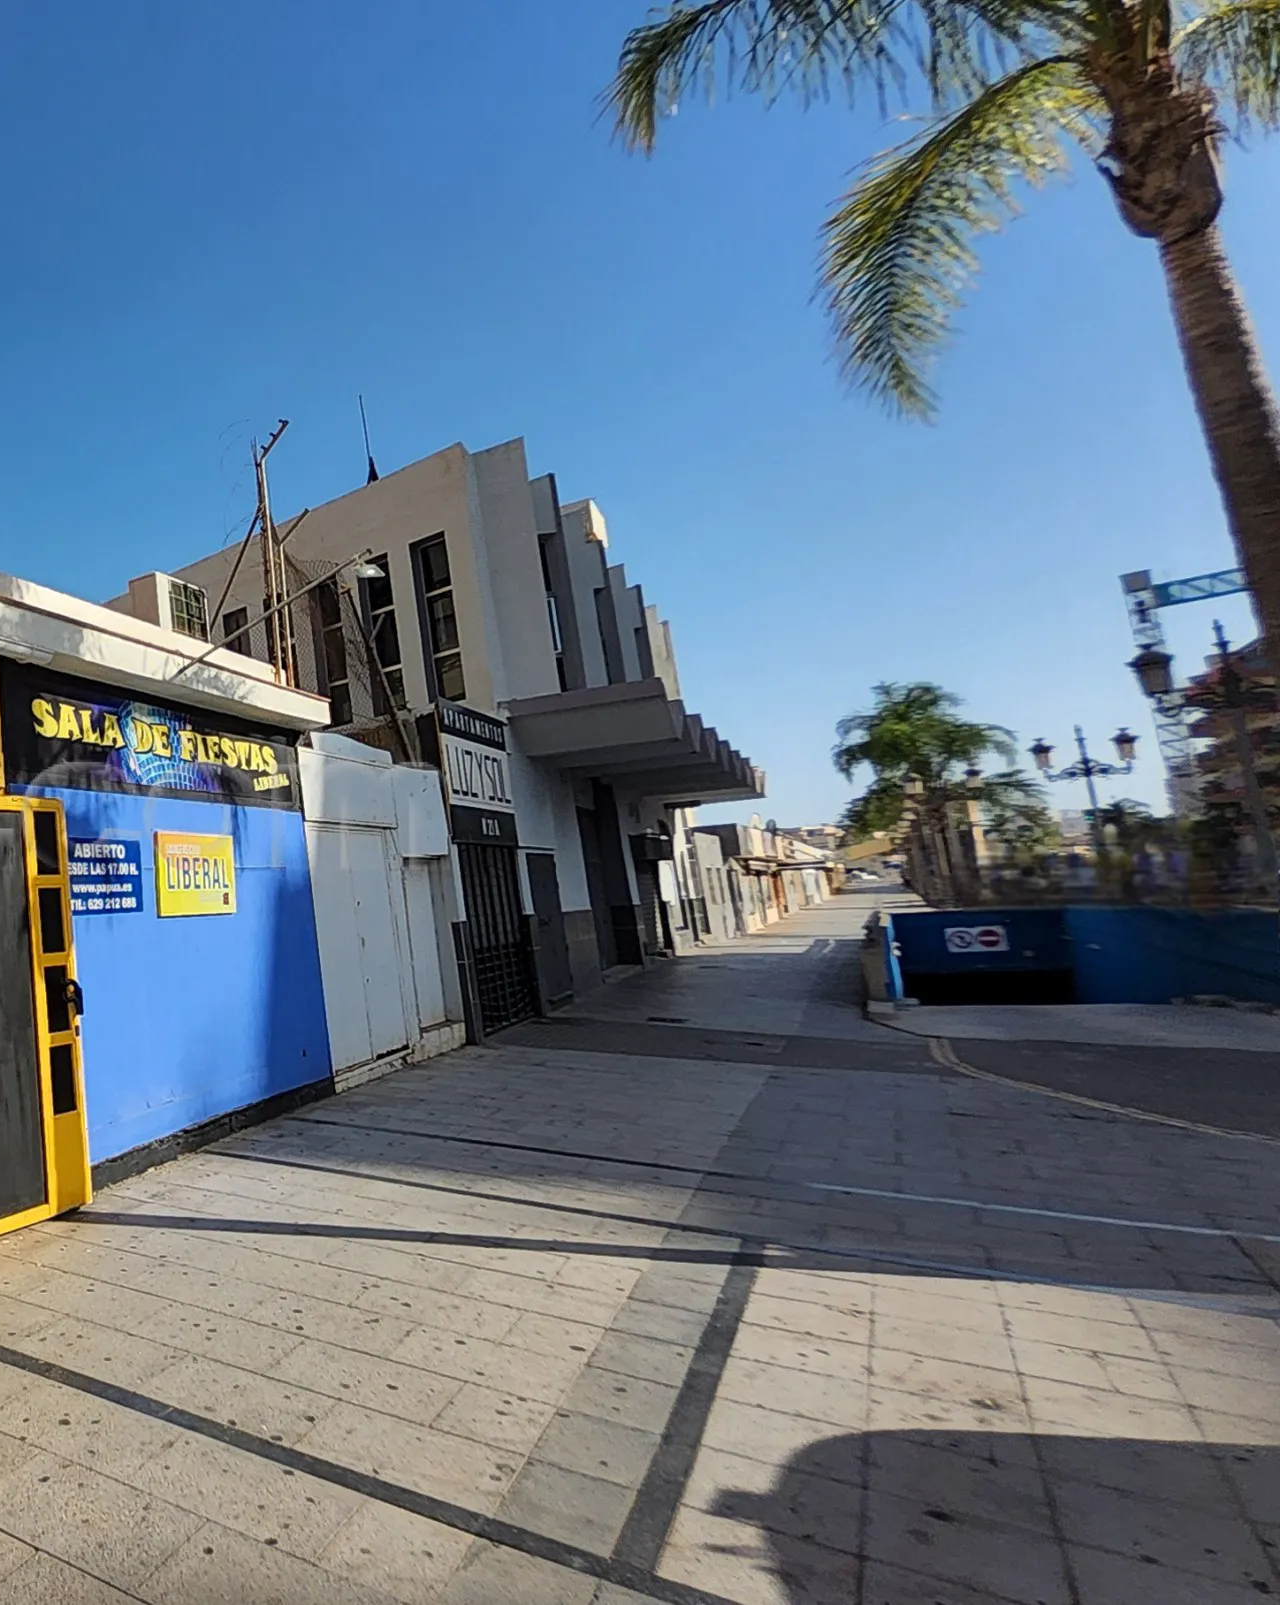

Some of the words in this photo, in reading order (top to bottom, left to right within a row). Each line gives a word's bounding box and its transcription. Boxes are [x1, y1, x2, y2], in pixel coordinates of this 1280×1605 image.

[443, 707, 503, 744] APARTAMENTOS
[31, 698, 126, 749] SALA
[132, 718, 171, 758] DE
[178, 730, 279, 775] FIESTAS
[254, 774, 290, 792] LIBERAL
[73, 842, 126, 859] ABIERTO
[67, 862, 89, 876] ESDE
[90, 862, 107, 875] LAS
[166, 855, 230, 890] LIBERAL
[71, 882, 133, 895] www.papua.es
[104, 896, 121, 909] 212
